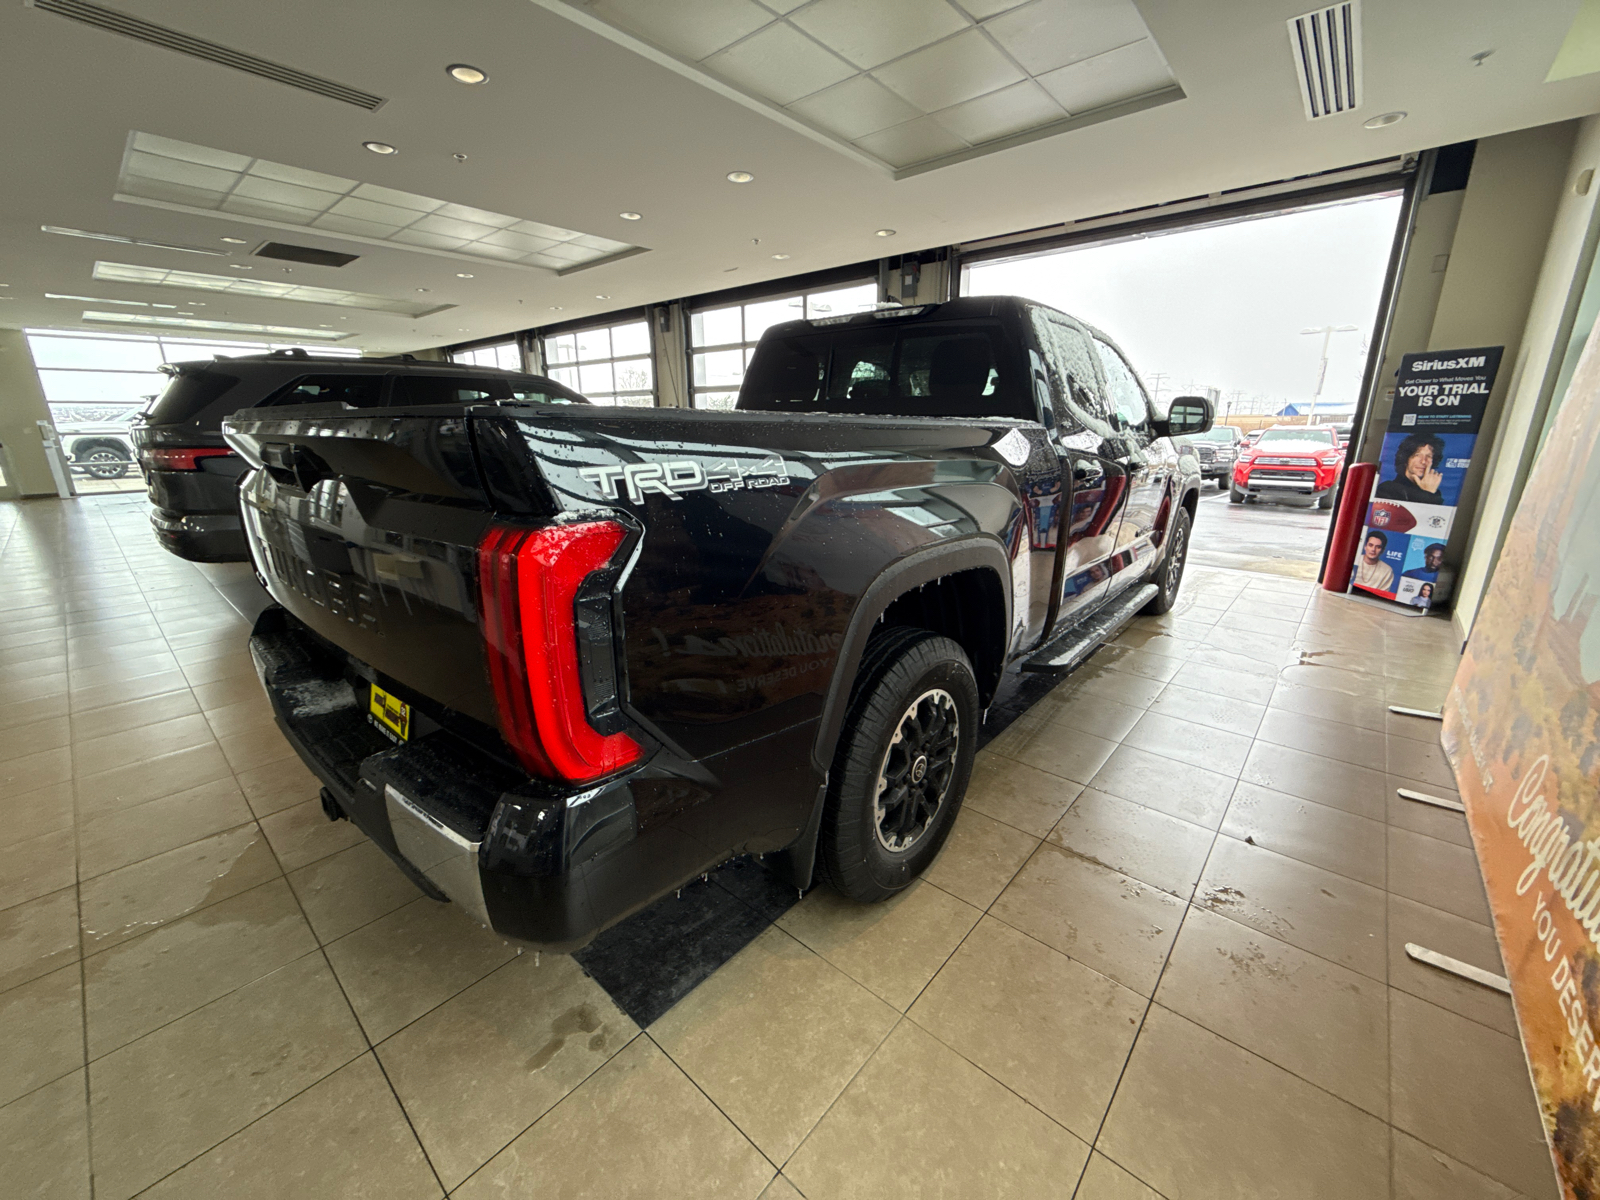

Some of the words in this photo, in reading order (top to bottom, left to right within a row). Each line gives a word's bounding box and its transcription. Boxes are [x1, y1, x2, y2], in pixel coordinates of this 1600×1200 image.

[1412, 356, 1486, 371] SiriusXM
[1399, 384, 1440, 397] YOUR
[1442, 383, 1489, 395] TRIAL
[1418, 396, 1433, 407] IS
[1435, 395, 1461, 407] ON
[578, 460, 709, 506] TRD
[709, 478, 745, 494] OFF
[746, 476, 791, 490] ROAD
[1374, 515, 1389, 526] NFL
[1532, 891, 1562, 962] YOU
[1551, 954, 1600, 1113] DESER
